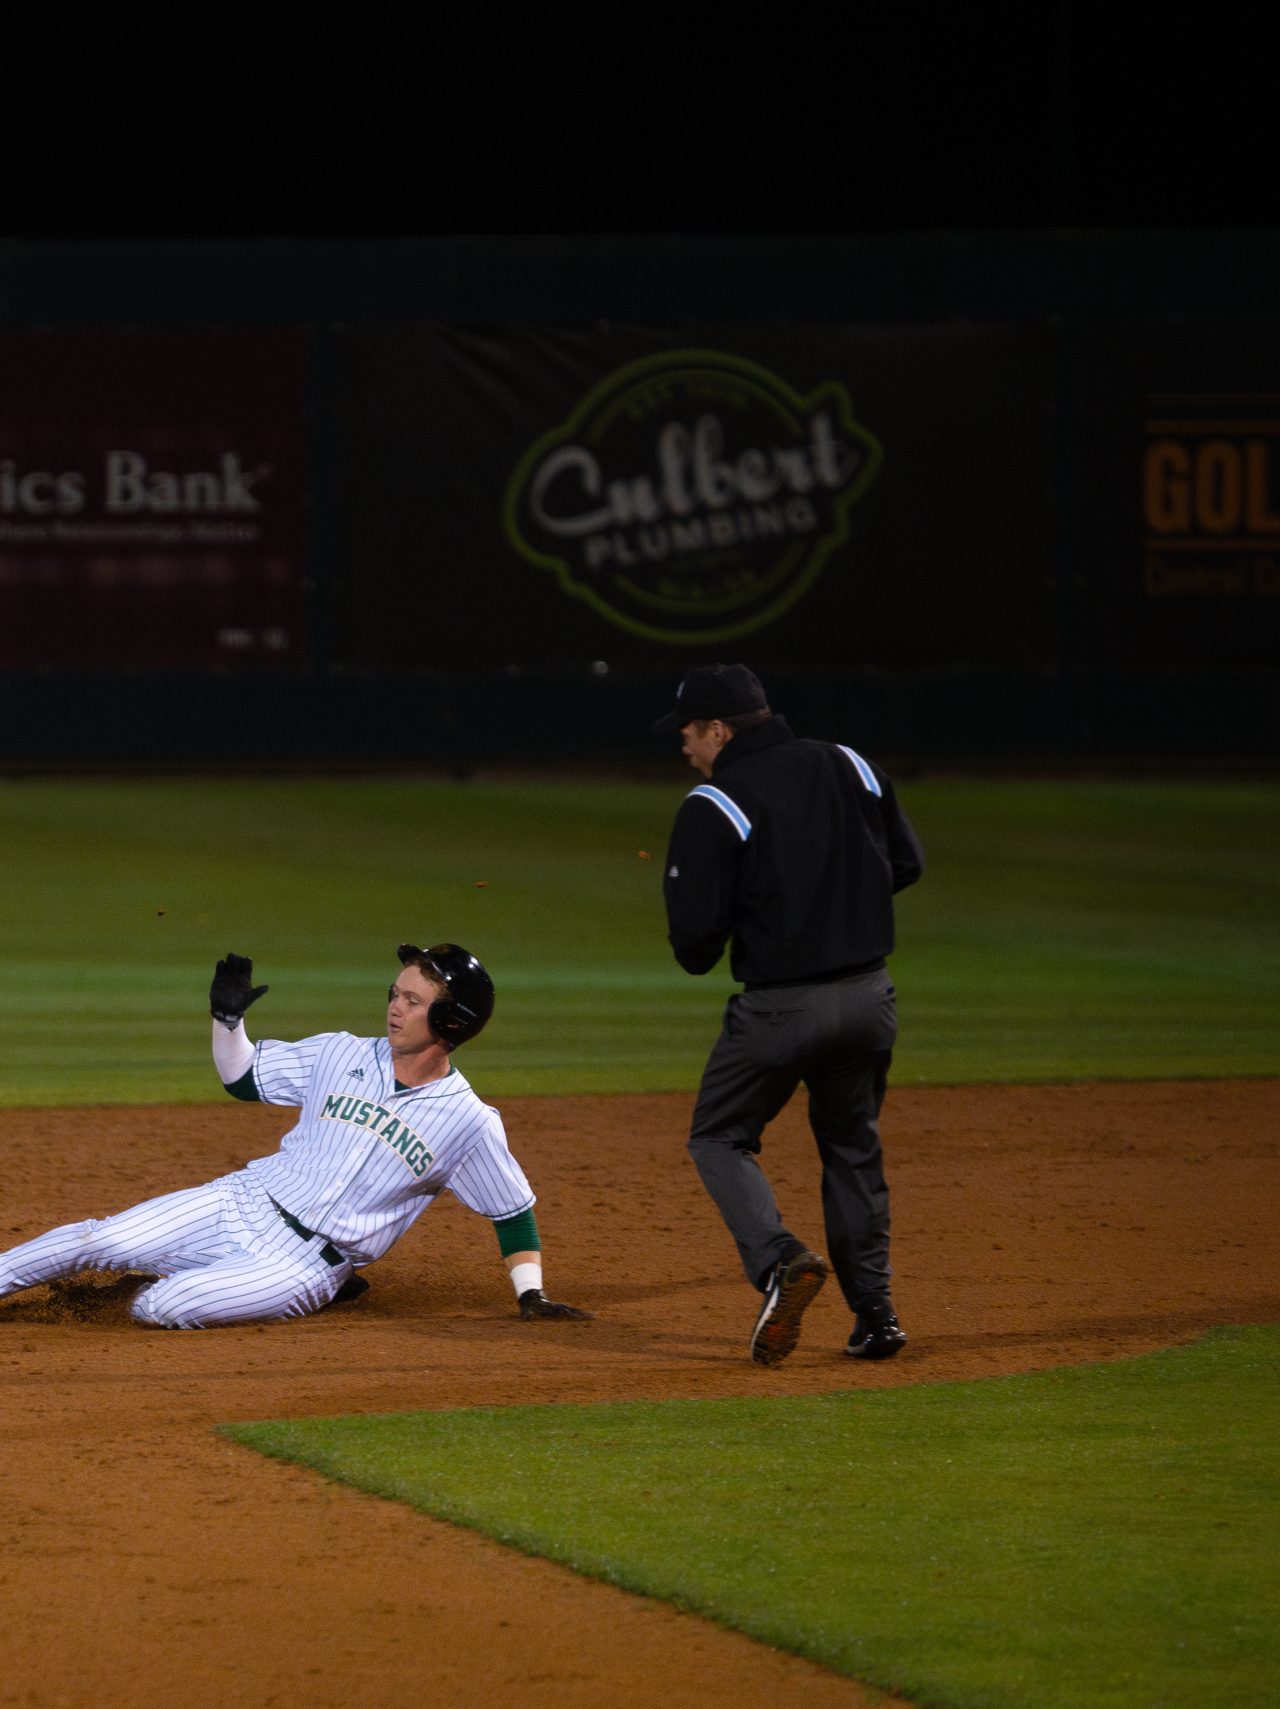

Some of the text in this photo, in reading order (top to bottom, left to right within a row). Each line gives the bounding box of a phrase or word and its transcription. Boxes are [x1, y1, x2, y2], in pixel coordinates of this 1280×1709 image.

[104, 450, 263, 514] Bank
[529, 411, 860, 537] Culbert
[1143, 440, 1280, 534] GOL
[584, 499, 817, 569] PLUMBING
[321, 1094, 435, 1178] MUSTANGS
